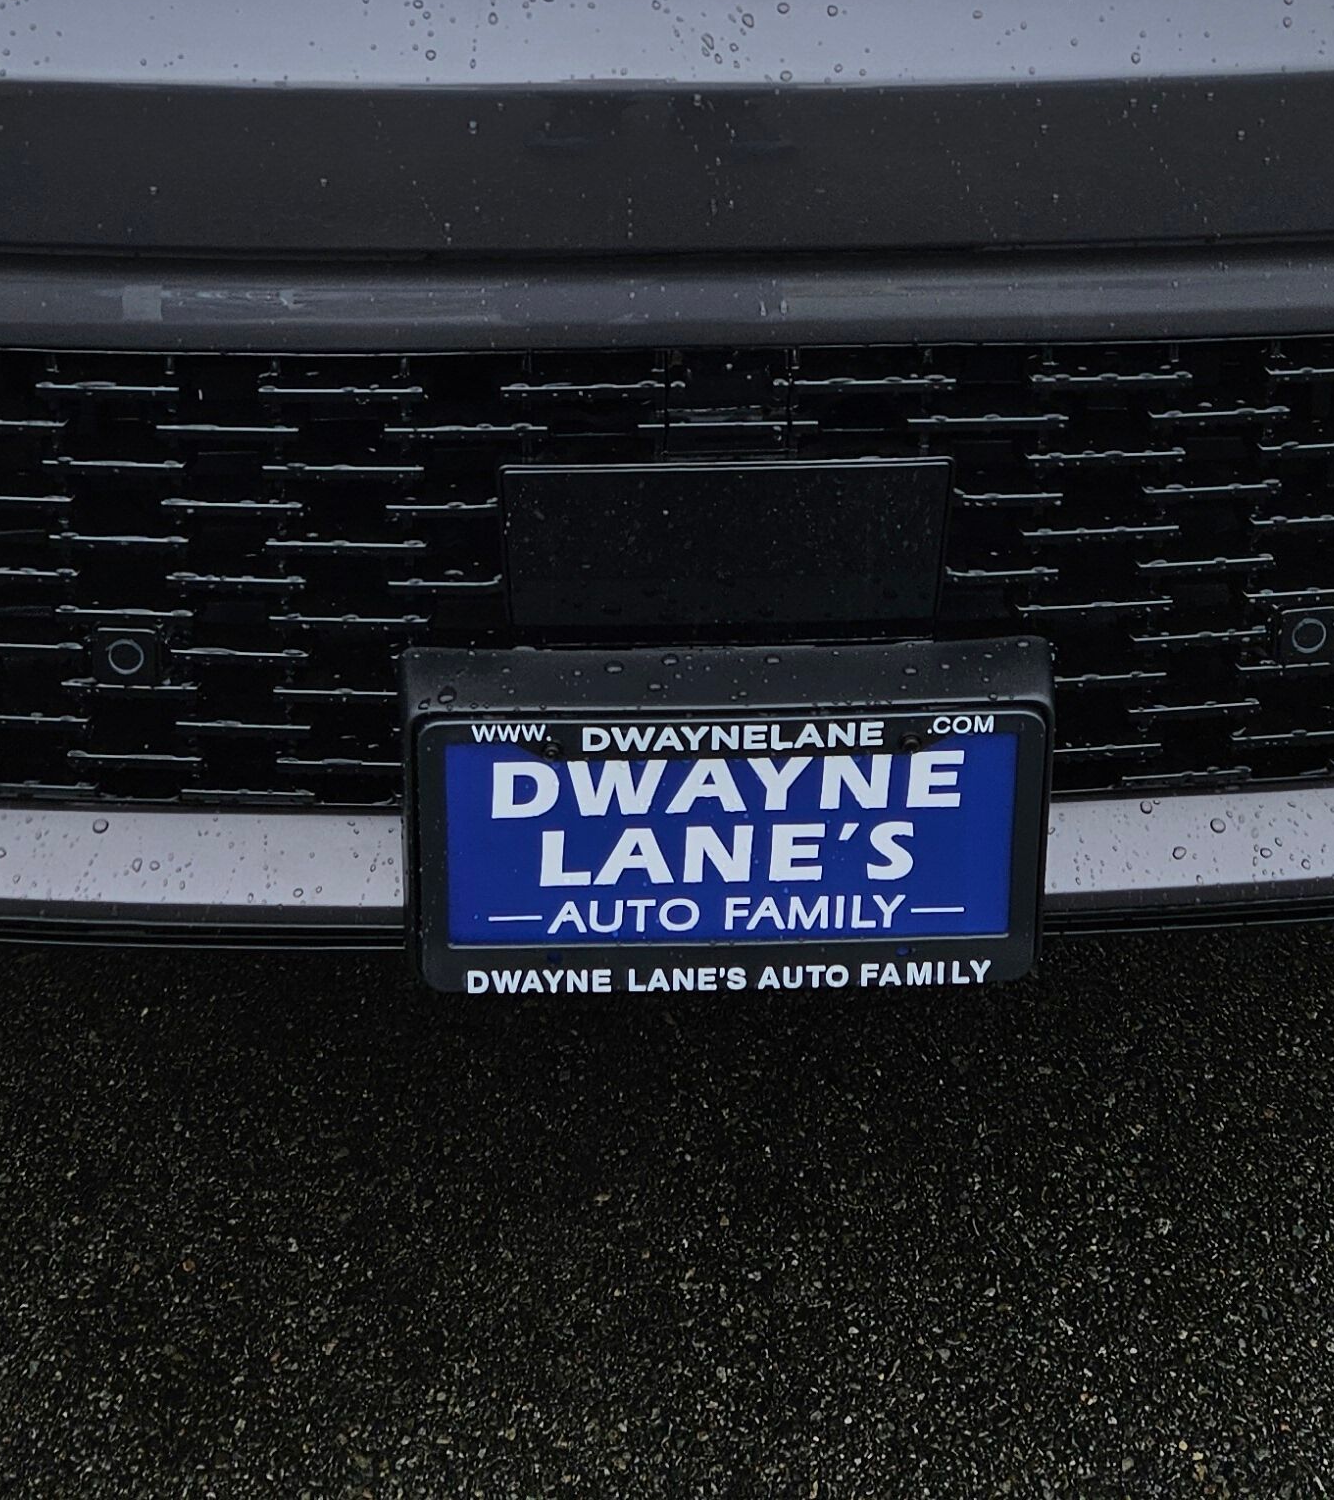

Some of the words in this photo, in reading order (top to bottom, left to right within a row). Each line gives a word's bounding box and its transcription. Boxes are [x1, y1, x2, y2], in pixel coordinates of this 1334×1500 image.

[471, 723, 552, 743] WWW.
[581, 721, 885, 753] DWAYNELANE
[925, 713, 995, 736] .COM
[490, 749, 965, 820] DWAYNE
[538, 820, 915, 888] LANE'S
[547, 896, 701, 935] AUTO
[724, 893, 906, 932] FAMILY
[466, 967, 612, 995] DWAYNE
[627, 965, 747, 993] LANE'S
[757, 963, 850, 990] AUTO
[859, 958, 992, 988] FAMILY
